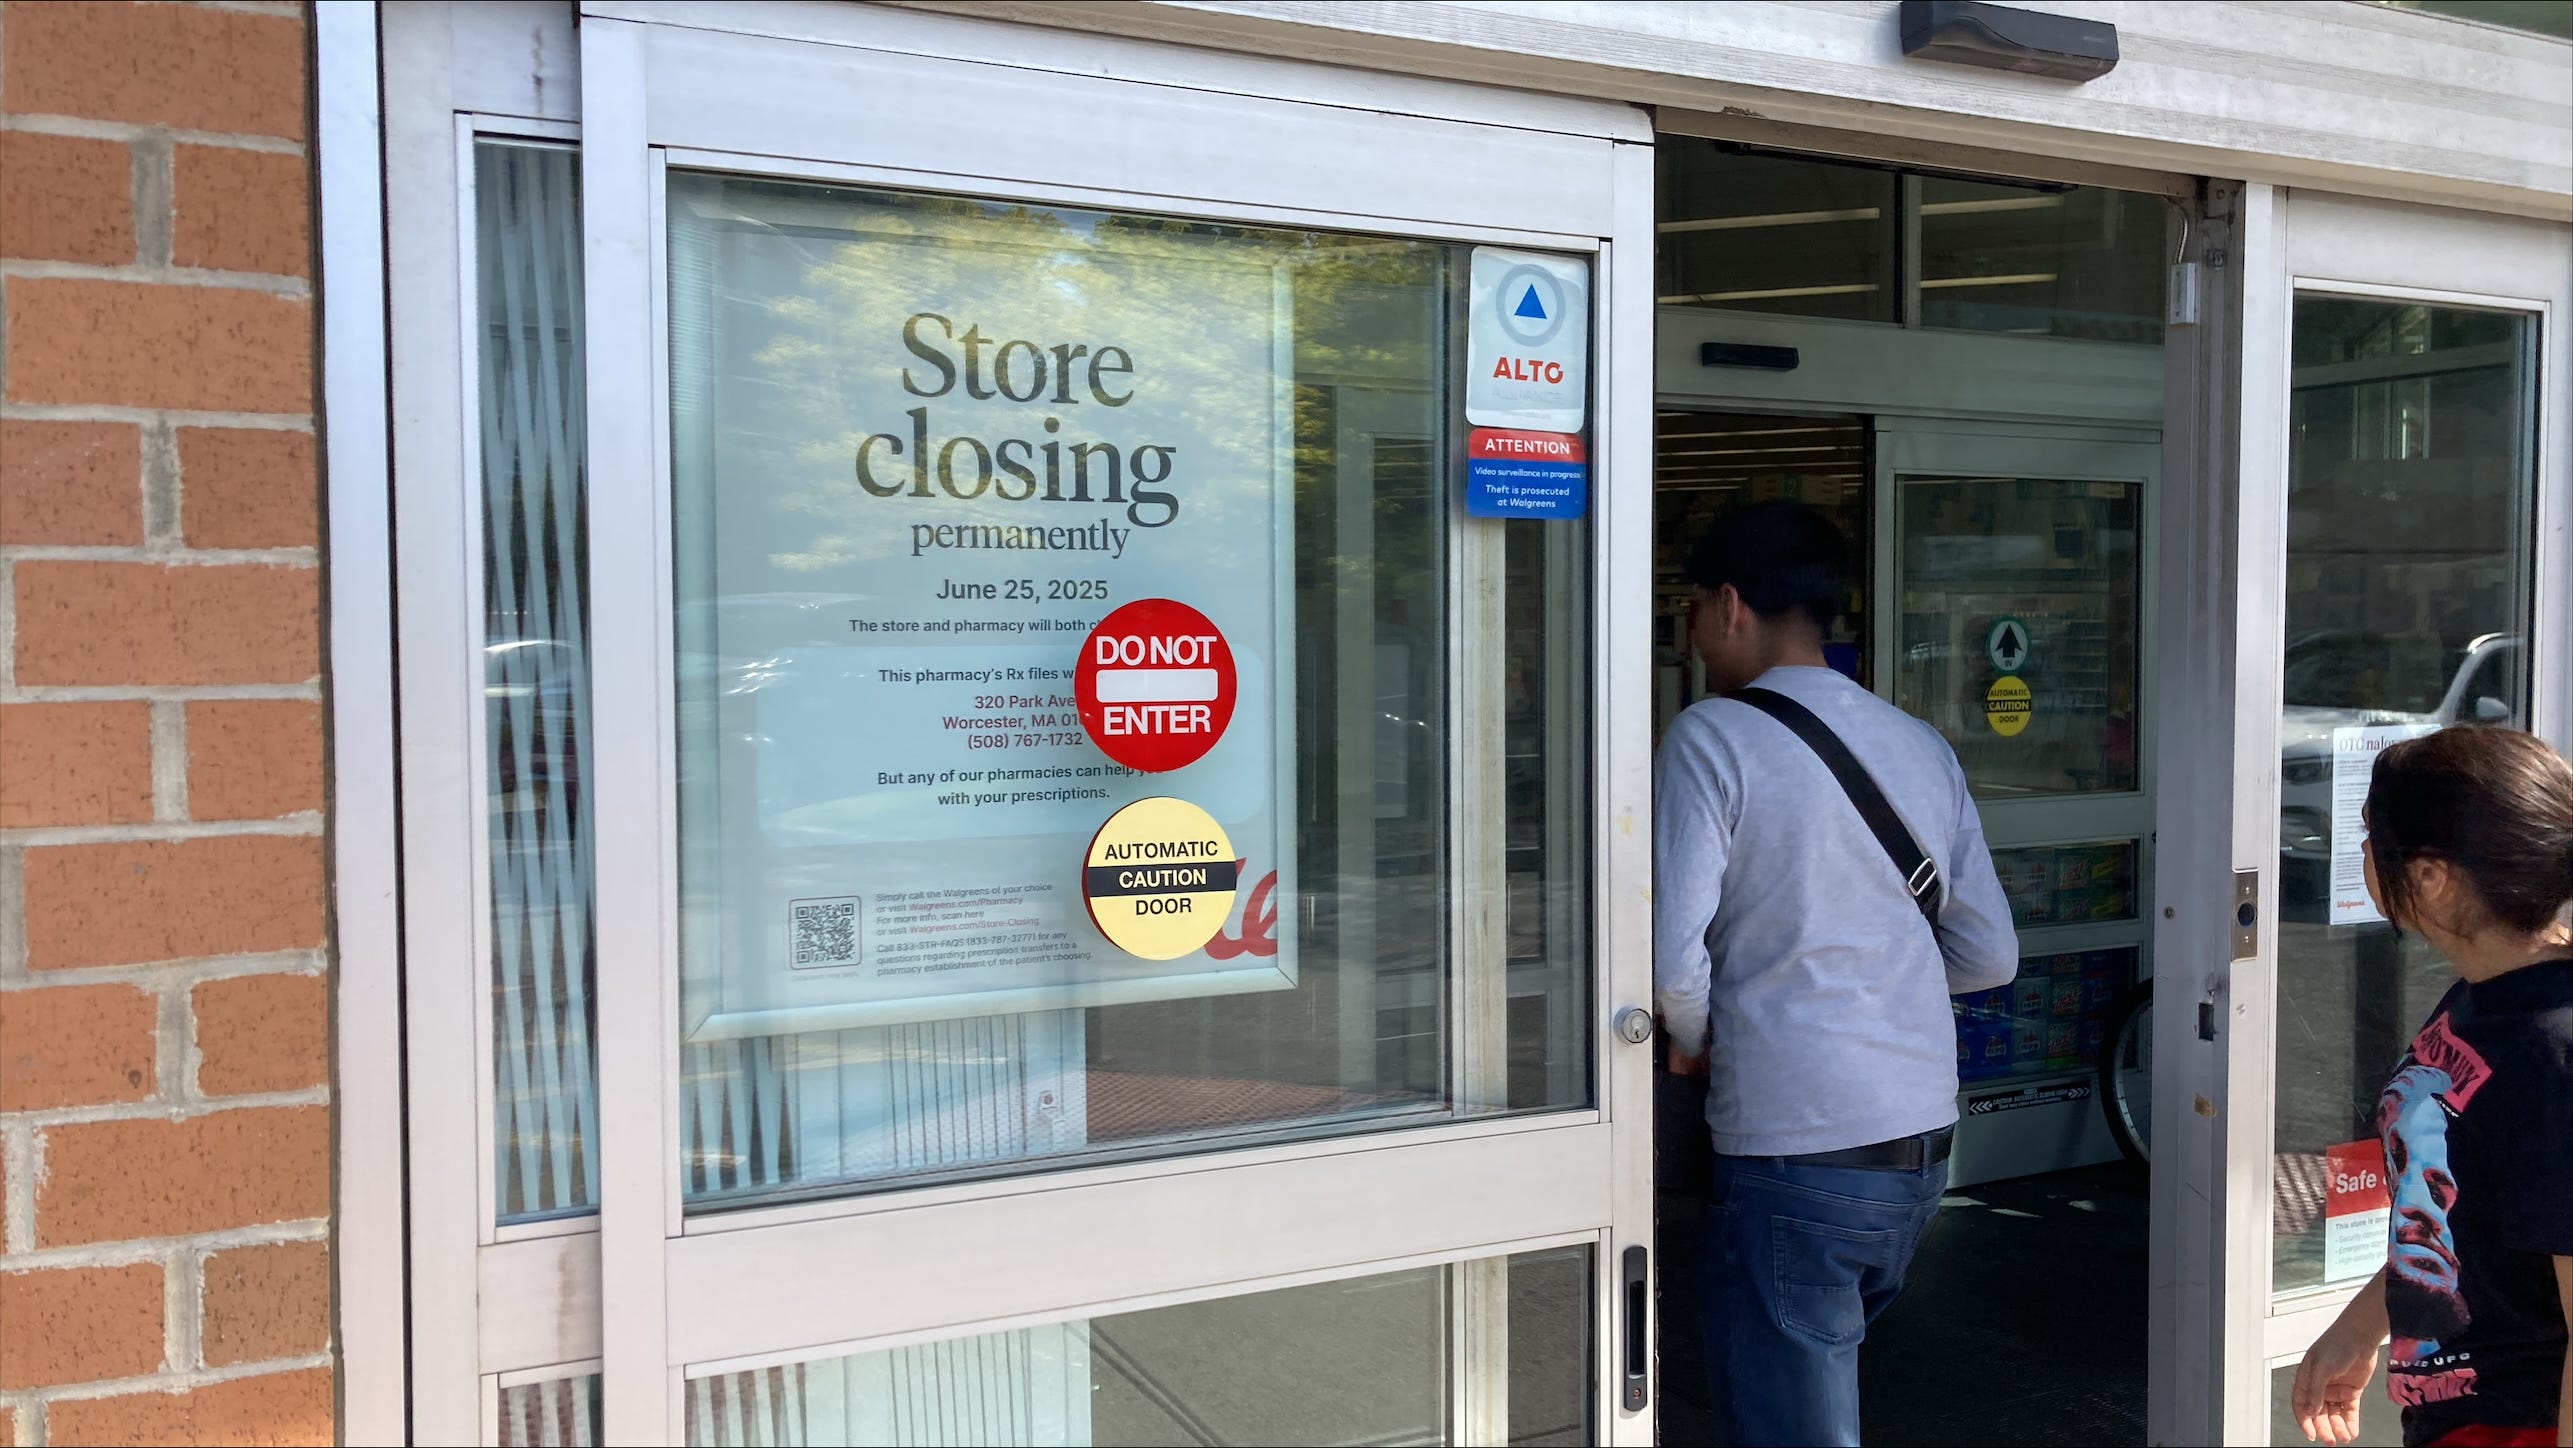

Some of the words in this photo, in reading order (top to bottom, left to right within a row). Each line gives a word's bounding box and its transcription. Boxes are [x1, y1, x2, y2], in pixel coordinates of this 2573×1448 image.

[902, 312, 1134, 407] Store
[1493, 356, 1564, 384] ALTO
[1485, 438, 1570, 455] ATTENTION
[855, 406, 1180, 528] closing
[1475, 466, 1496, 476] Video
[1497, 468, 1541, 478] surveillance
[1542, 469, 1548, 478] in
[1549, 471, 1582, 480] progress
[1485, 484, 1509, 495] Theft
[1512, 486, 1519, 495] is
[1521, 487, 1570, 497] prosecuted
[1497, 499, 1507, 507] at
[1509, 498, 1556, 509] Walgreens
[911, 518, 1130, 560] permanently
[937, 579, 997, 600] June
[1004, 579, 1040, 605] 25,
[1048, 579, 1108, 600] 2025
[848, 619, 878, 632] The
[882, 619, 919, 632] store
[924, 619, 951, 632] and
[954, 618, 1024, 634] pharmacy
[1028, 618, 1051, 631] will
[1055, 619, 1085, 631] both
[1096, 635, 1146, 666] DO
[1150, 635, 1218, 666] NOT
[2005, 659, 2012, 667] IN
[879, 669, 911, 682] This
[916, 668, 1003, 684] pharmacy's
[1007, 668, 1025, 680] Rx
[1029, 667, 1059, 680] files
[1990, 688, 2028, 697] AUTOMATIC
[975, 696, 1004, 709] 320
[1009, 695, 1043, 708] Park
[1048, 695, 1075, 707] Ave
[1989, 700, 2029, 711] CAUTION
[942, 715, 1026, 730] Worcester,
[1031, 714, 1056, 727] MA
[1104, 705, 1212, 735] ENTER
[1998, 715, 2019, 723] DOOR
[968, 733, 1008, 750] (508)
[1014, 732, 1083, 747] 767-1732
[2340, 737, 2363, 751] OTC
[878, 772, 903, 785] But
[908, 772, 935, 786] any
[940, 770, 954, 783] of
[959, 771, 984, 782] our
[988, 766, 1072, 783] pharmacies
[1076, 767, 1100, 778] can
[1105, 764, 1134, 778] help
[938, 792, 970, 805] with
[974, 793, 1006, 807] your
[1011, 786, 1111, 804] prescriptions.
[1104, 840, 1218, 860] AUTOMATIC
[1119, 868, 1207, 889] CAUTION
[876, 893, 906, 903] Simply
[909, 892, 925, 900] call
[927, 890, 941, 899] the
[943, 888, 990, 898] Walgreens
[992, 887, 1000, 895] of
[1003, 886, 1022, 896] your
[1024, 883, 1053, 892] choice
[889, 904, 906, 912] visit
[909, 897, 1023, 912] Walgreens.com/Pharmacy
[1136, 897, 1192, 915] DOOR
[877, 916, 892, 924] For
[893, 915, 917, 923] more
[919, 913, 937, 922] info,
[941, 912, 962, 920] scan
[964, 910, 984, 919] here
[889, 927, 907, 935] visit
[909, 917, 1040, 936] Walgreens.com/Store-Closing
[877, 943, 895, 953] Call
[1038, 933, 1050, 941] for
[1052, 932, 1067, 941] any
[877, 953, 921, 965] questions
[923, 950, 965, 962] regarding
[967, 945, 1018, 959] prescription
[1021, 943, 1058, 953] transfers
[1060, 942, 1069, 950] to
[877, 965, 922, 977] pharmacy
[924, 960, 986, 972] establishment
[988, 959, 997, 967] of
[999, 957, 1014, 965] the
[1016, 954, 1051, 965] patient's
[1053, 951, 1093, 963] choosing.
[2336, 1169, 2377, 1194] Safe
